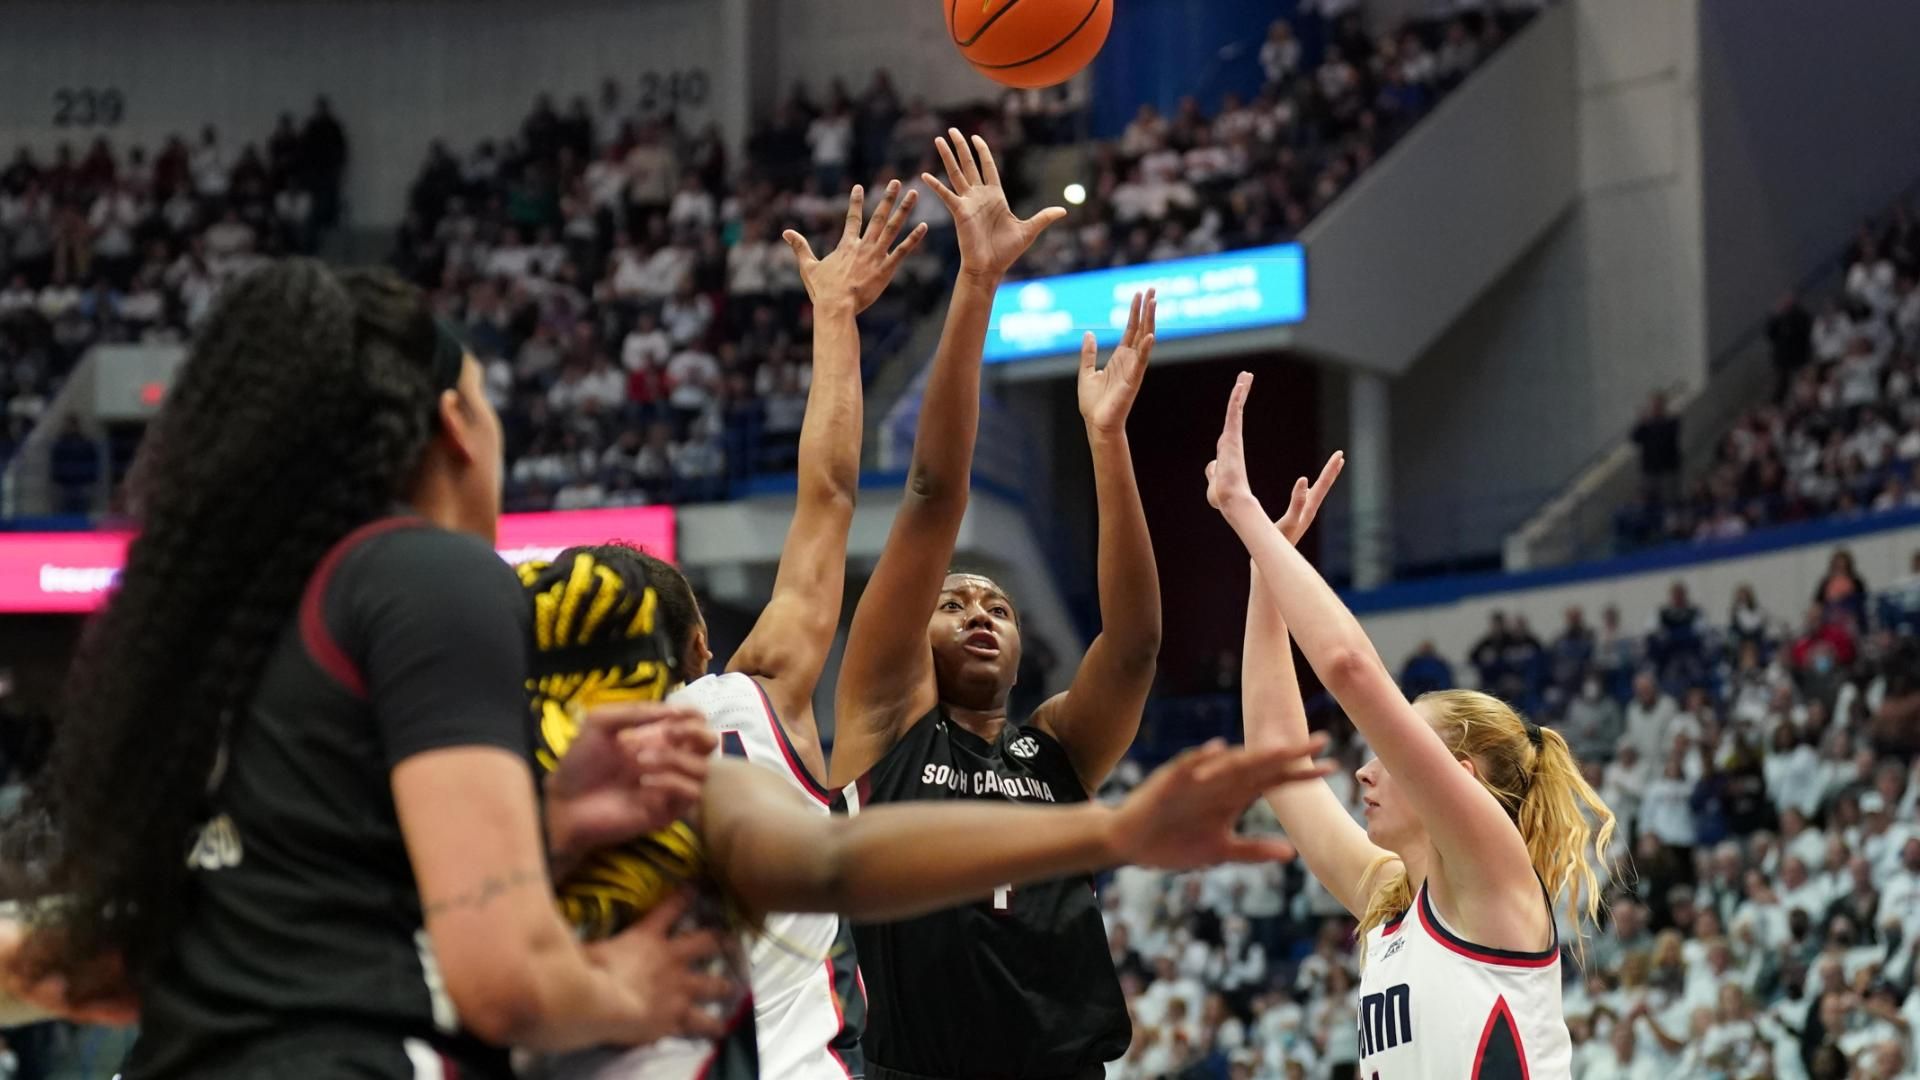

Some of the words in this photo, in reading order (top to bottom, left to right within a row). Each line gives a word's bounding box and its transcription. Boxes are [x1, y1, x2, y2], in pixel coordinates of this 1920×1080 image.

[53, 87, 126, 128] 239
[1009, 736, 1040, 758] SEC
[921, 763, 968, 794] SOUH
